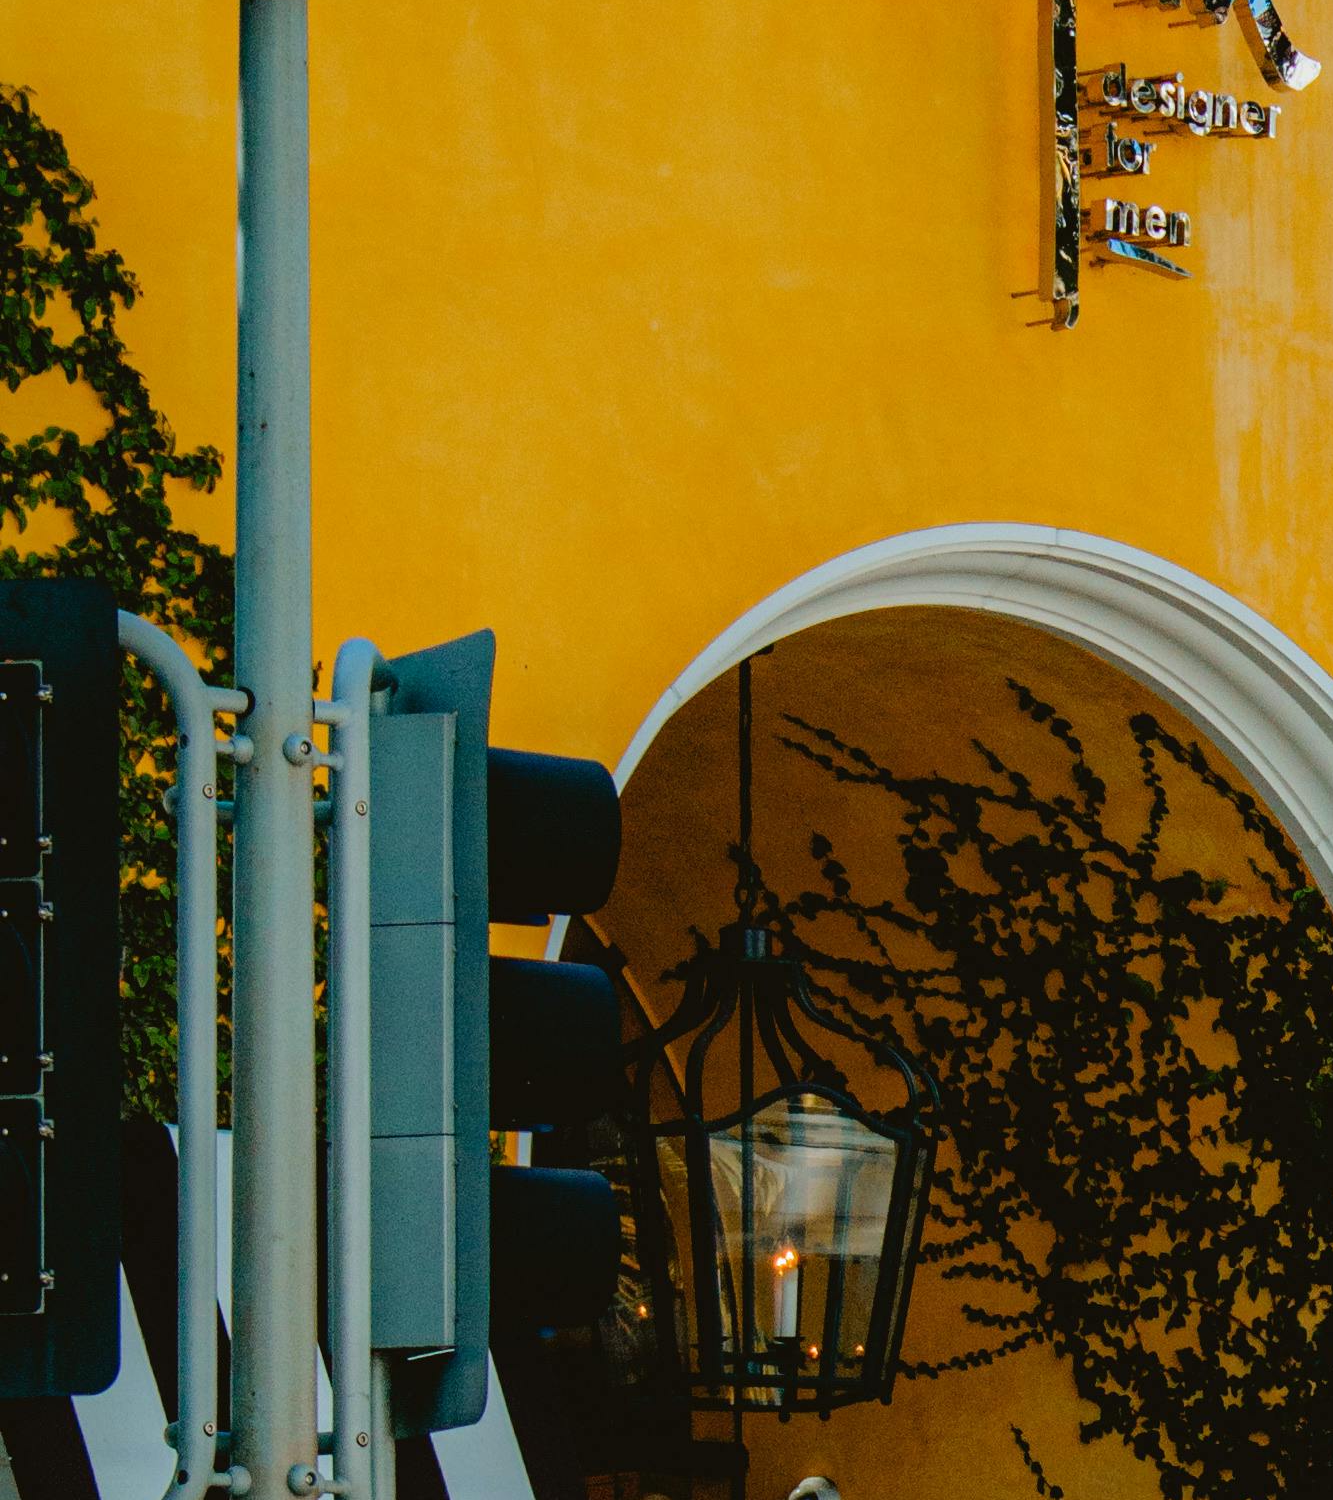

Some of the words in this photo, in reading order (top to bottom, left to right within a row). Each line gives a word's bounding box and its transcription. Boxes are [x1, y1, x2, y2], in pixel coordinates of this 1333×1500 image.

[1102, 63, 1282, 140] designer
[1105, 121, 1156, 175] for
[1105, 198, 1192, 247] men
